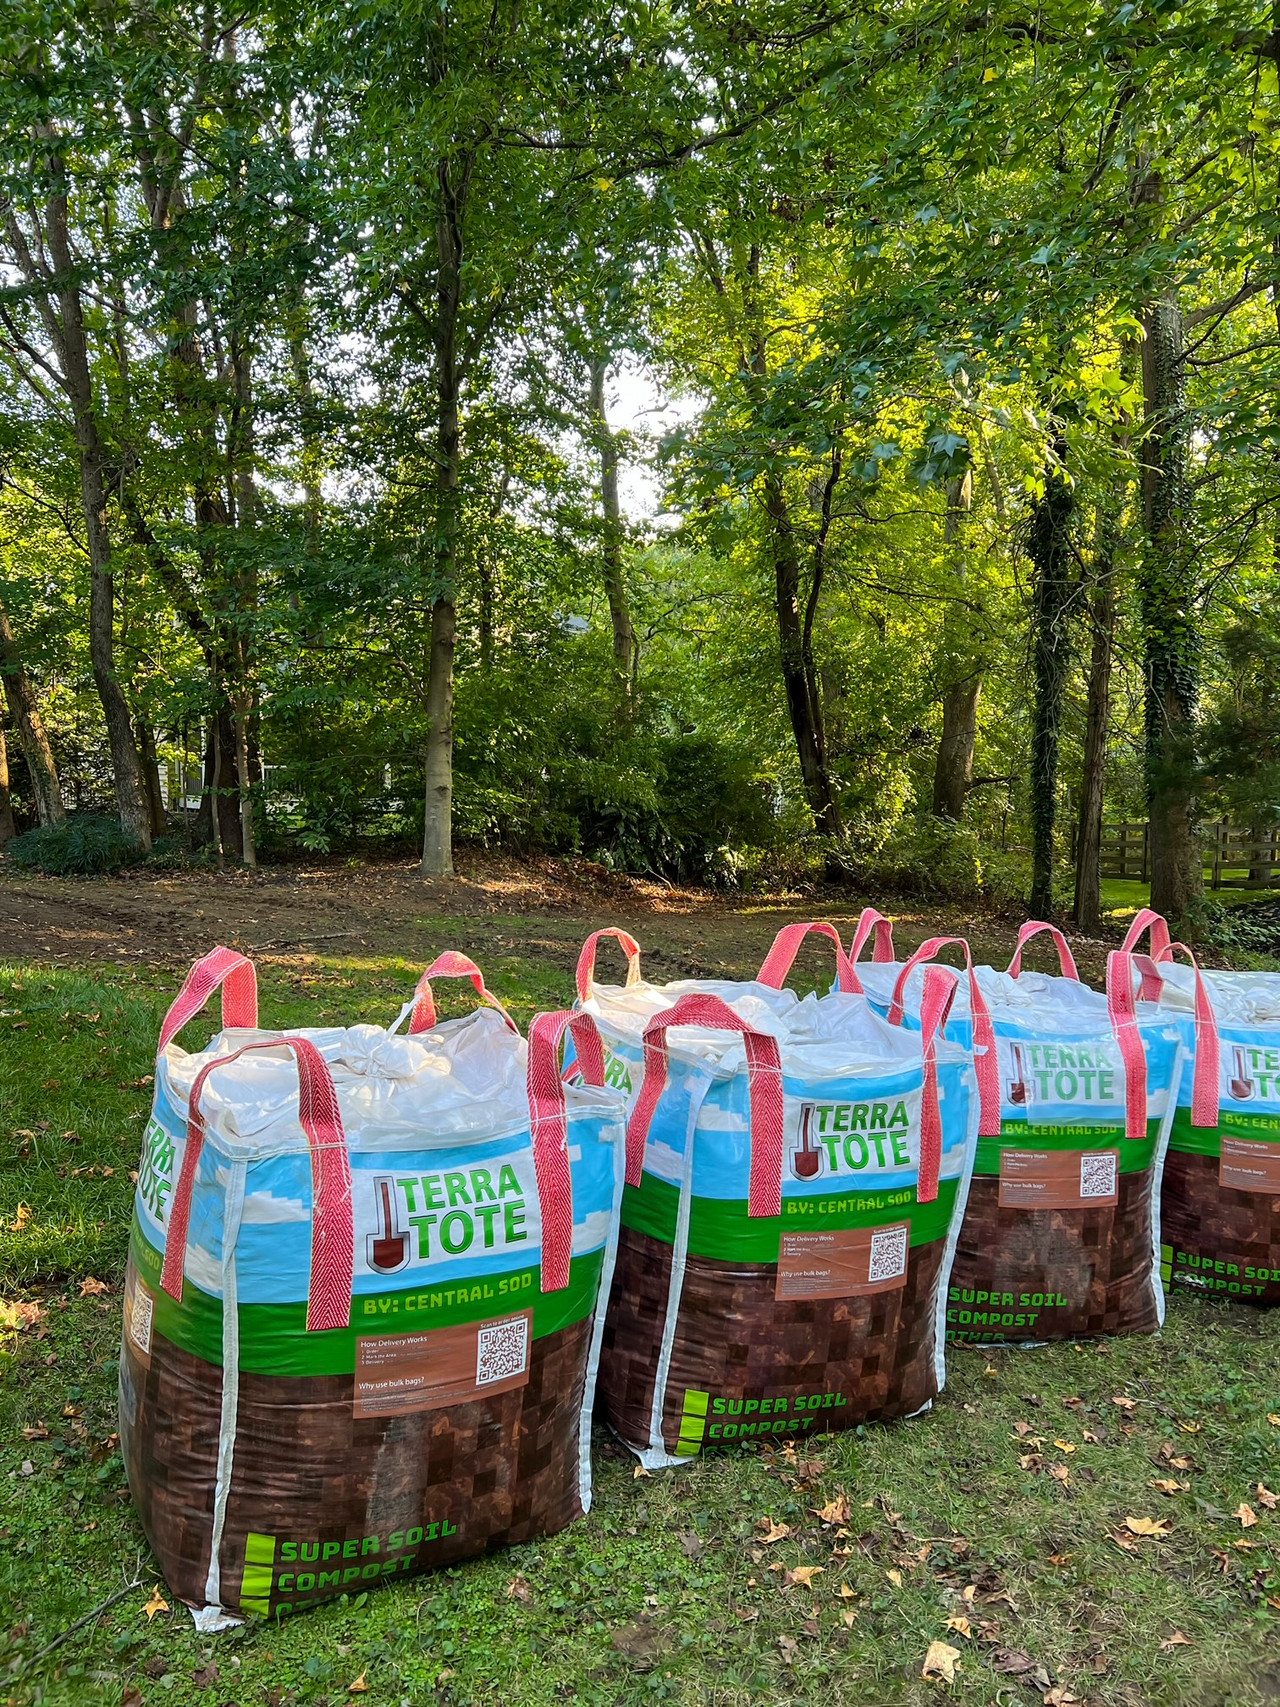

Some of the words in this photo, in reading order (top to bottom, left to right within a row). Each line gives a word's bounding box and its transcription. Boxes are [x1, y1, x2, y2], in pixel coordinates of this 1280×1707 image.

[1026, 1045, 1113, 1068] TERRA
[1034, 1070, 1114, 1101] TOTE
[816, 1101, 909, 1132] TERRA
[820, 1130, 911, 1171] TOTE
[397, 1164, 524, 1212] TERRA
[818, 1197, 884, 1214] CENTRAL
[409, 1199, 528, 1259] TOTE
[1176, 1251, 1240, 1276] SUPER
[363, 1299, 399, 1315] BY:
[405, 1284, 494, 1311] CENTRAL
[498, 1273, 532, 1295] SOD
[948, 1287, 1014, 1306] SUPER
[1019, 1293, 1068, 1307] SOIL
[946, 1309, 1039, 1326] COMPOST
[378, 1337, 407, 1347] Delivery
[407, 1335, 428, 1344] Works
[359, 1382, 375, 1391] Why
[389, 1379, 404, 1387] bulk
[405, 1376, 425, 1386] bags?
[711, 1397, 789, 1416] SUPER
[793, 1392, 848, 1412] SOIL
[708, 1417, 814, 1439] COMPOST
[280, 1535, 381, 1562] SUPER
[386, 1519, 457, 1552] SOIL
[277, 1553, 416, 1593] COMPOST
